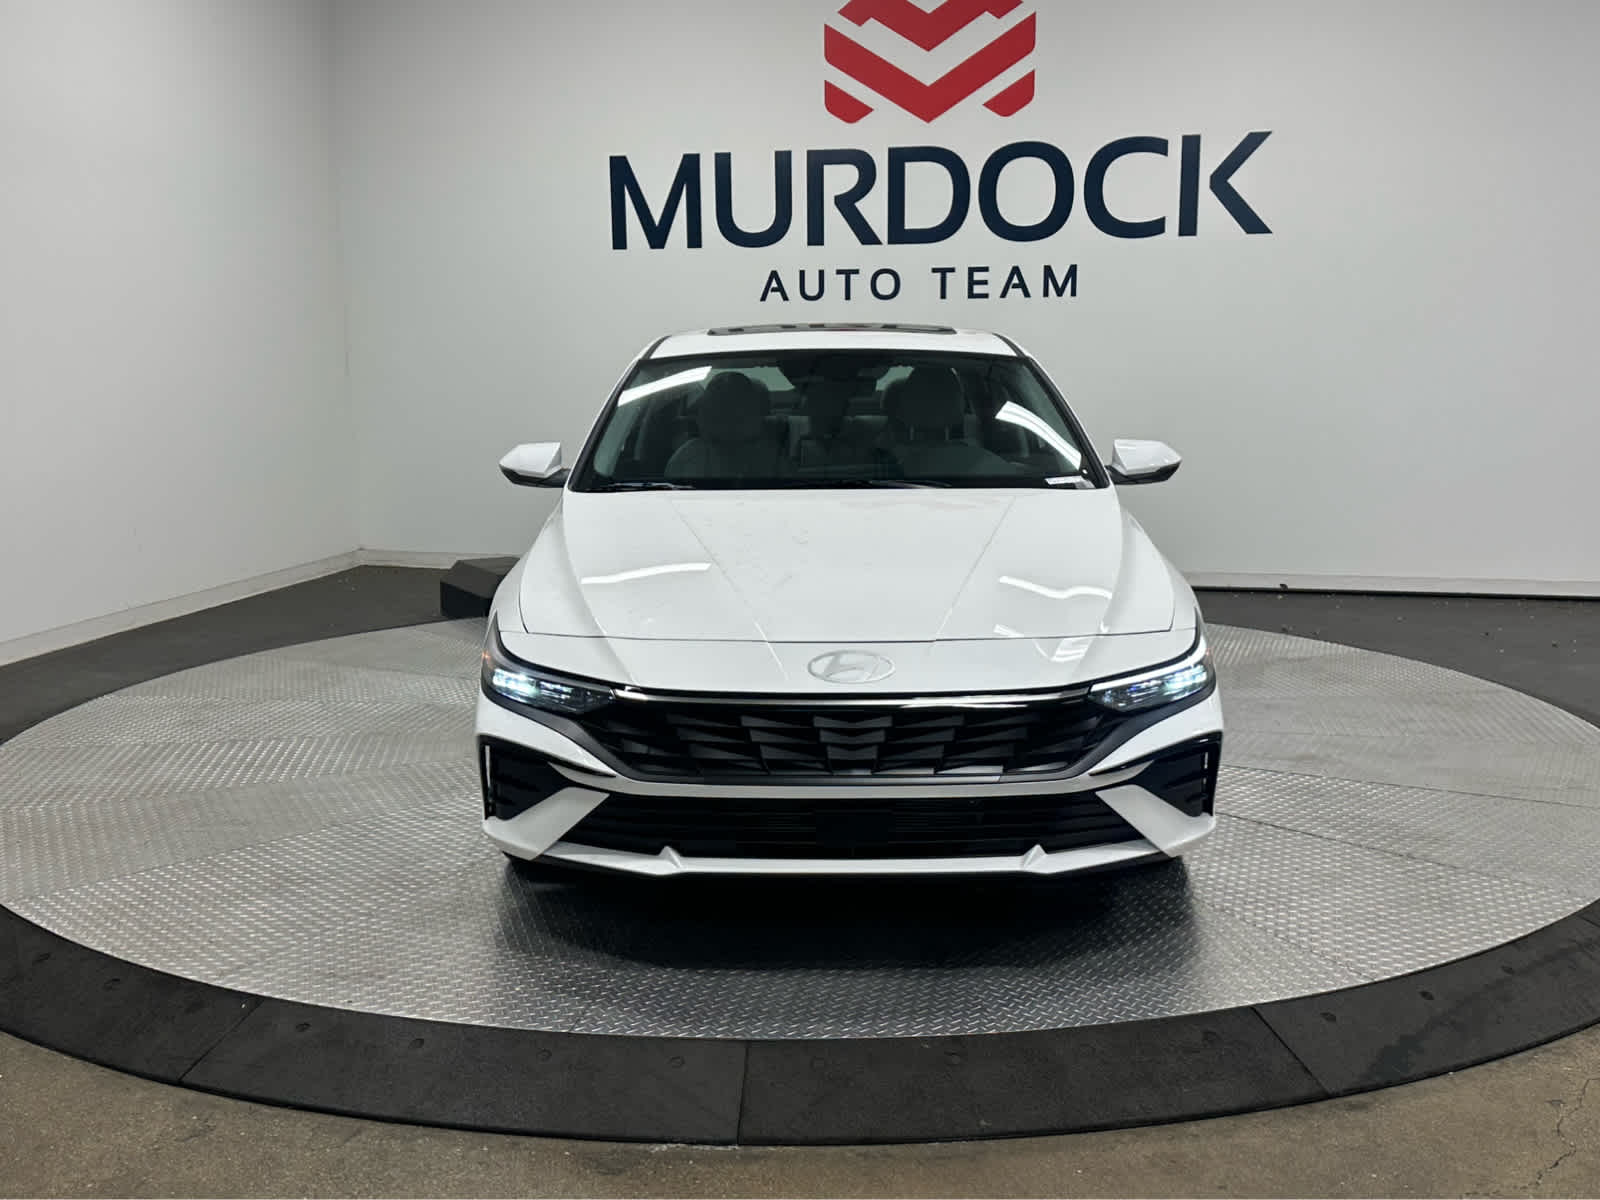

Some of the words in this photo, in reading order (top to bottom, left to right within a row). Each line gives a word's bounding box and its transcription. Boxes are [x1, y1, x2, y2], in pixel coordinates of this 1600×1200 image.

[609, 131, 1273, 251] MURDOCK
[760, 268, 901, 302] AUTO
[931, 264, 1078, 299] TEAM
